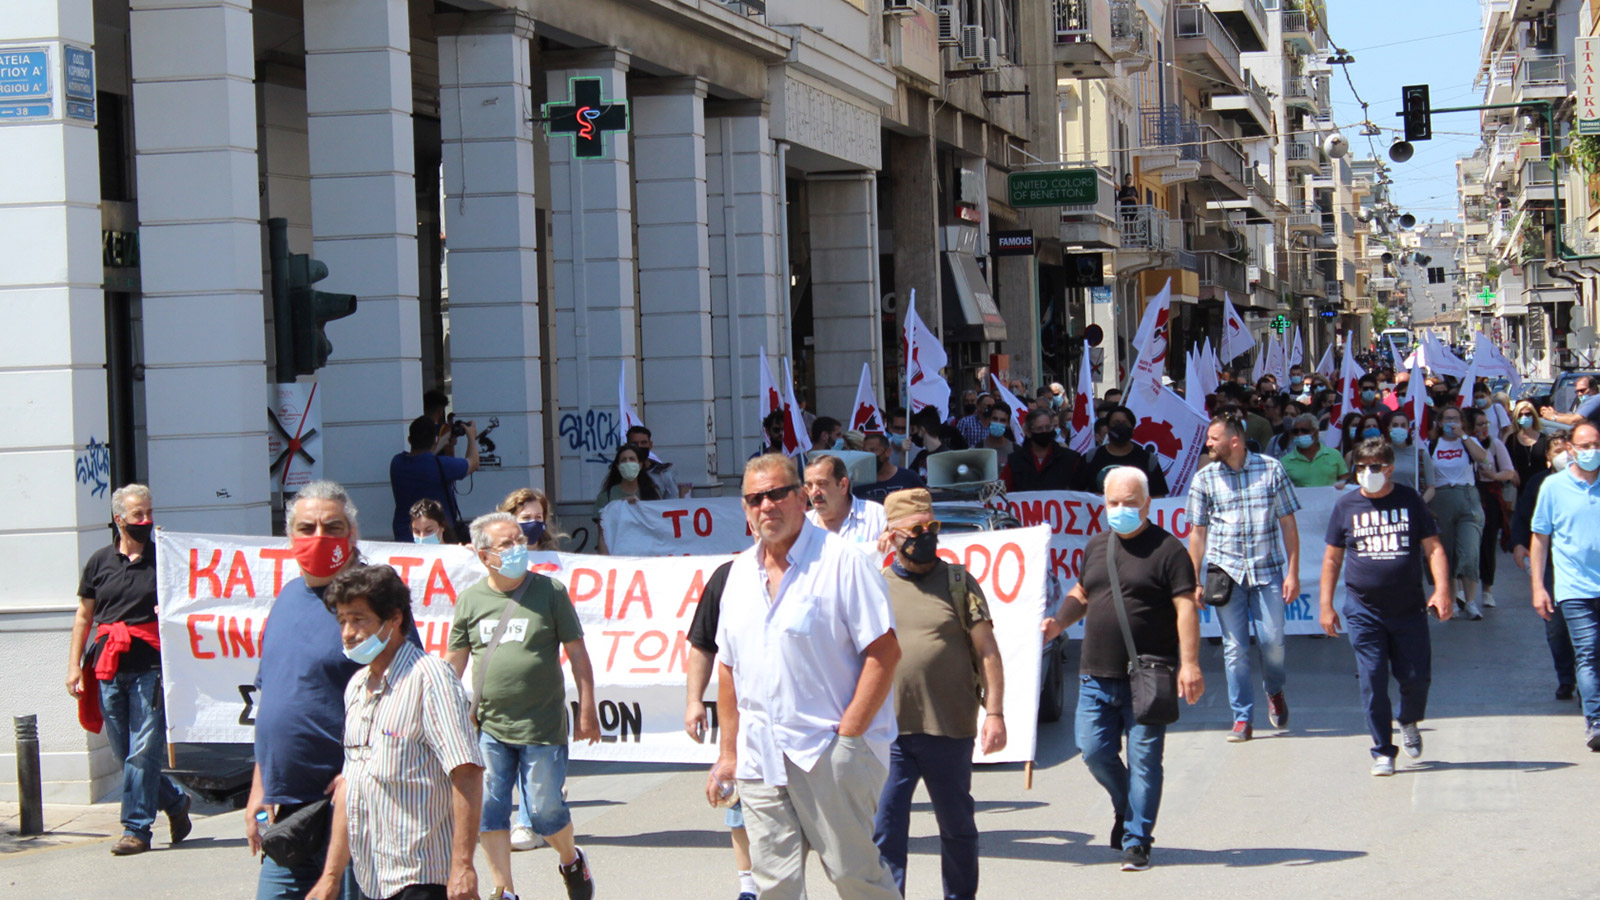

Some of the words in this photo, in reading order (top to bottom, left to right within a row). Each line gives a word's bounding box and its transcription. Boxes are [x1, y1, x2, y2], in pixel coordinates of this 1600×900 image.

[1582, 41, 1596, 118] ΙΤΑΛΙΚΑ
[16, 108, 28, 116] 38
[1013, 179, 1048, 190] UNITED
[1051, 177, 1094, 188] COLORS
[1013, 191, 1027, 200] OF
[999, 236, 1032, 246] FAMOUS
[662, 507, 713, 538] ΤΟ
[1353, 508, 1409, 529] LONDON
[1380, 522, 1409, 535] QUALITY
[1365, 533, 1399, 552] 1914
[188, 548, 296, 599] ΚΑΤ
